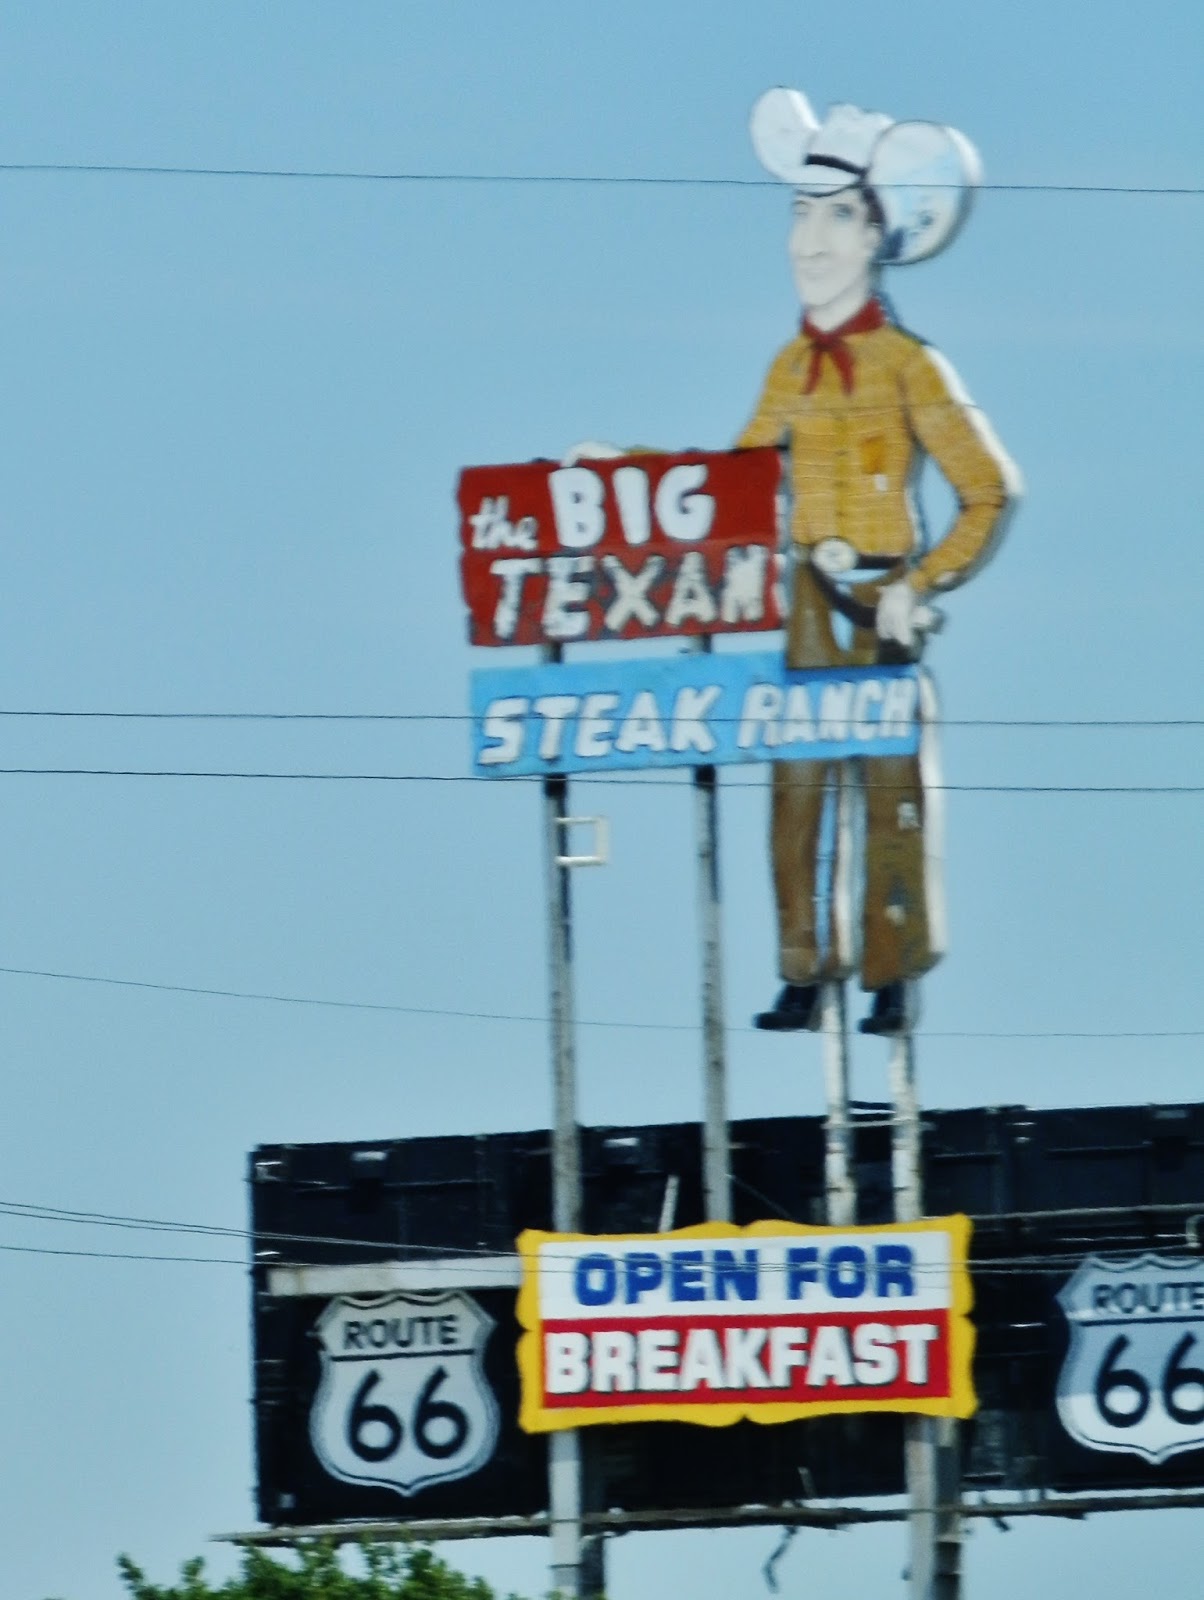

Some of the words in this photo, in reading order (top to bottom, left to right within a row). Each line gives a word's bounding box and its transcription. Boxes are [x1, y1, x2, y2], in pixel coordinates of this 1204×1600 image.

[468, 495, 539, 551] the
[548, 464, 716, 548] BIG
[490, 544, 770, 641] TEXAN
[478, 685, 721, 766] STEAK
[737, 678, 918, 749] RANCH
[573, 1247, 760, 1306] OPEN
[787, 1244, 915, 1299] FOR
[1093, 1281, 1204, 1314] ROUTE
[343, 1314, 459, 1350] ROUTE
[545, 1323, 938, 1394] BREAKFAST
[348, 1365, 469, 1463] 66
[1096, 1332, 1204, 1428] 66
